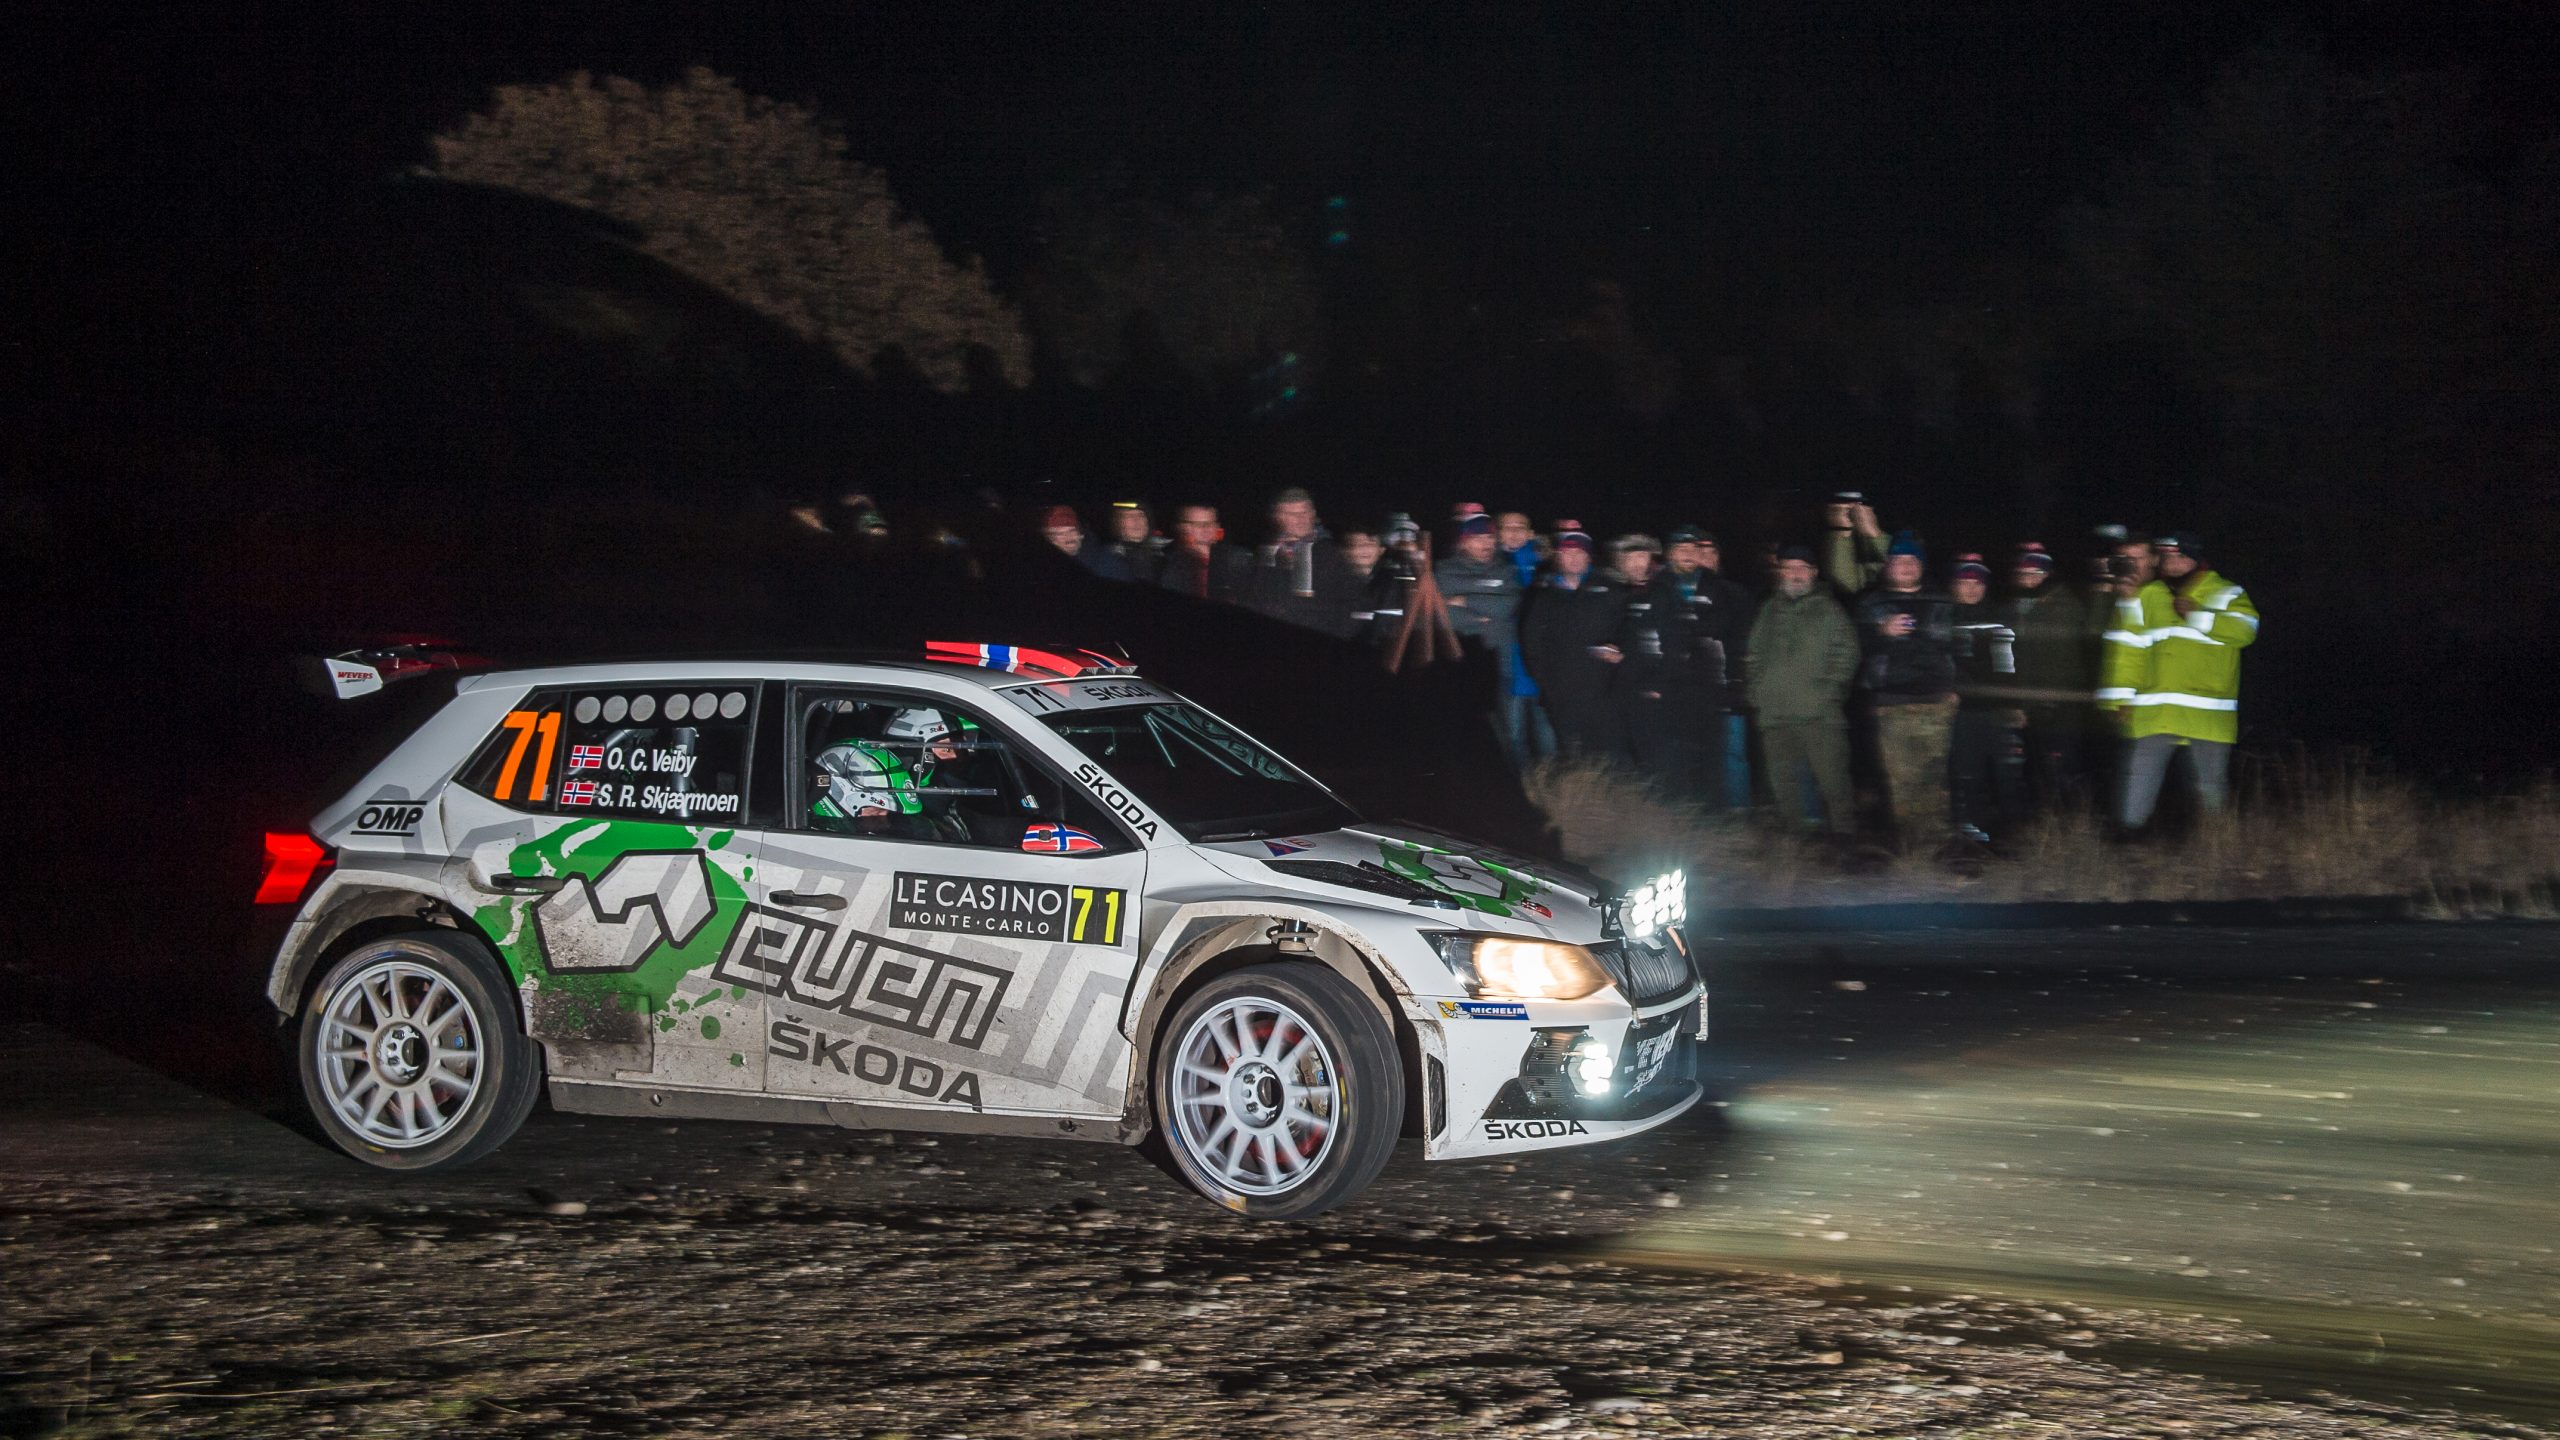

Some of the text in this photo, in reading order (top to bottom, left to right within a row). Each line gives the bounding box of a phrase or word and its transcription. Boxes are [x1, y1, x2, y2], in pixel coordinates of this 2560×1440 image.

[338, 671, 374, 680] WEVERS
[1012, 687, 1066, 711] 71
[494, 711, 561, 800] 71
[607, 749, 697, 778] O. C. Veiby
[598, 786, 739, 813] S. R. Skjærmoen
[1073, 763, 1159, 842] ŠKODA
[357, 806, 424, 831] OMP
[897, 877, 1063, 915] LE CASINO
[1072, 888, 1120, 944] 71
[1470, 1007, 1526, 1015] MICHELIN
[769, 1013, 983, 1113] ŠKODA
[1483, 1118, 1589, 1140] ŠKODA
